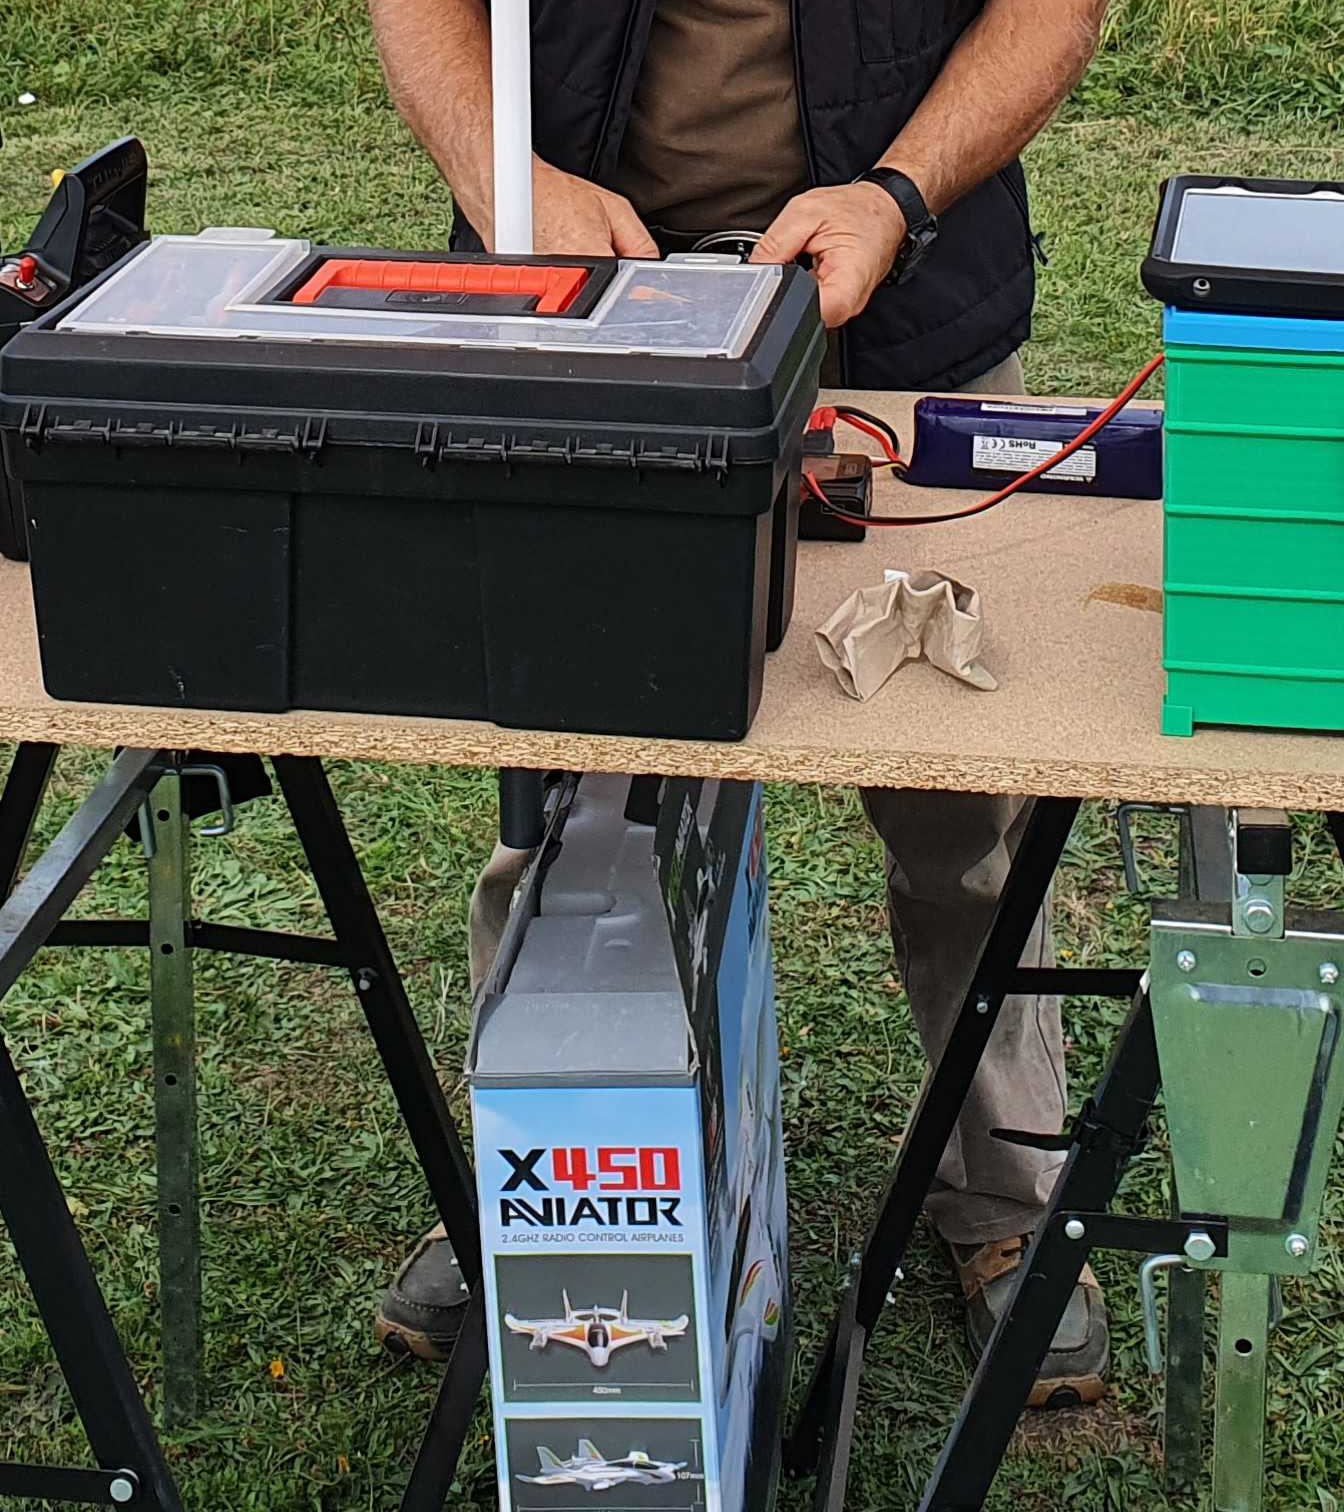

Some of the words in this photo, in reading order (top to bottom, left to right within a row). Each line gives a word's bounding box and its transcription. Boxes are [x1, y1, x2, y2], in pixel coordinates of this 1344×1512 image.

[497, 1147, 681, 1191] X450
[499, 1197, 683, 1227] AVIATOR
[542, 1233, 576, 1243] RADIO
[577, 1232, 629, 1242] CONTROL
[630, 1232, 684, 1243] AIRPLANES
